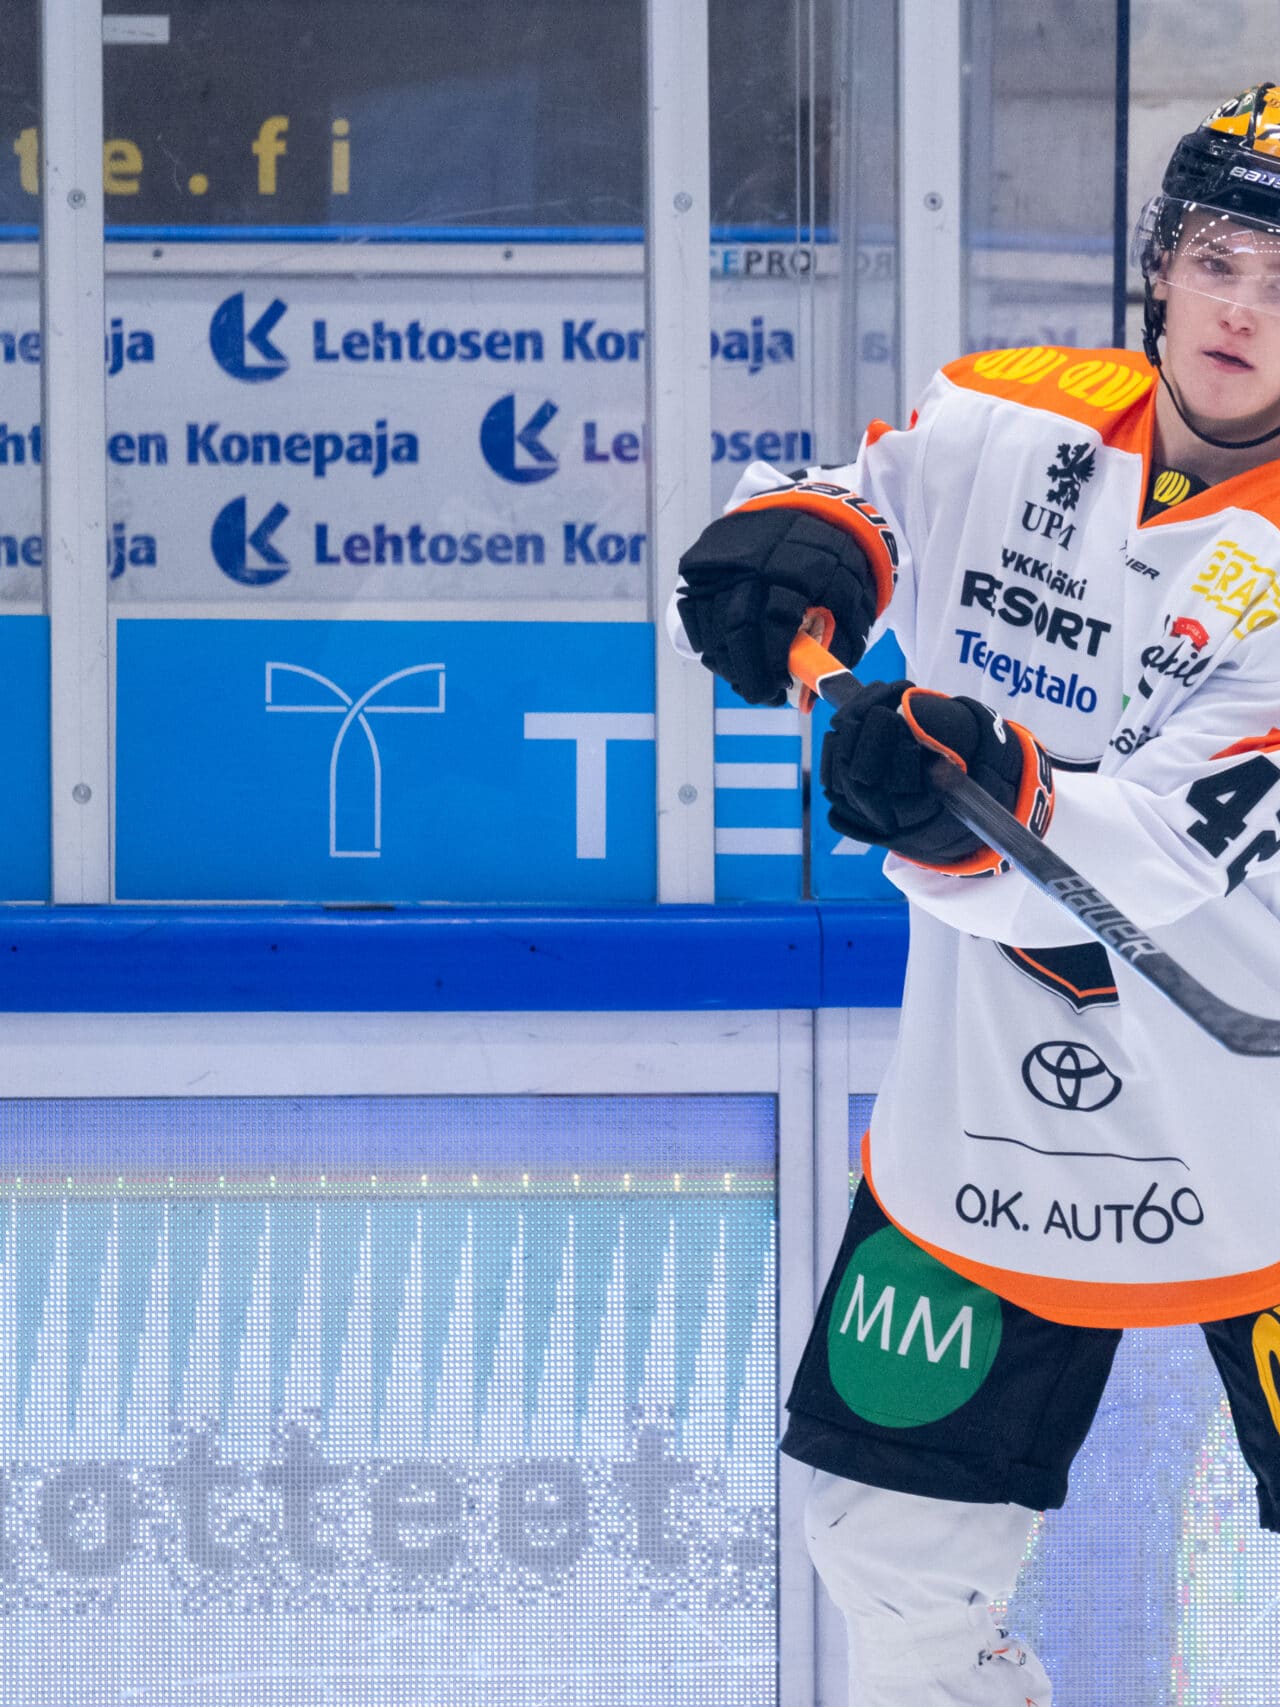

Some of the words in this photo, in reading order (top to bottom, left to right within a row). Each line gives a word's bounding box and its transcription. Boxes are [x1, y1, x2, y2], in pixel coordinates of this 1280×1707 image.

[313, 321, 545, 363] Lehtosen
[186, 421, 419, 478] Konepaja
[315, 524, 546, 567] Lehtosen
[955, 1182, 1030, 1233] O.K.
[839, 1273, 974, 1370] MM
